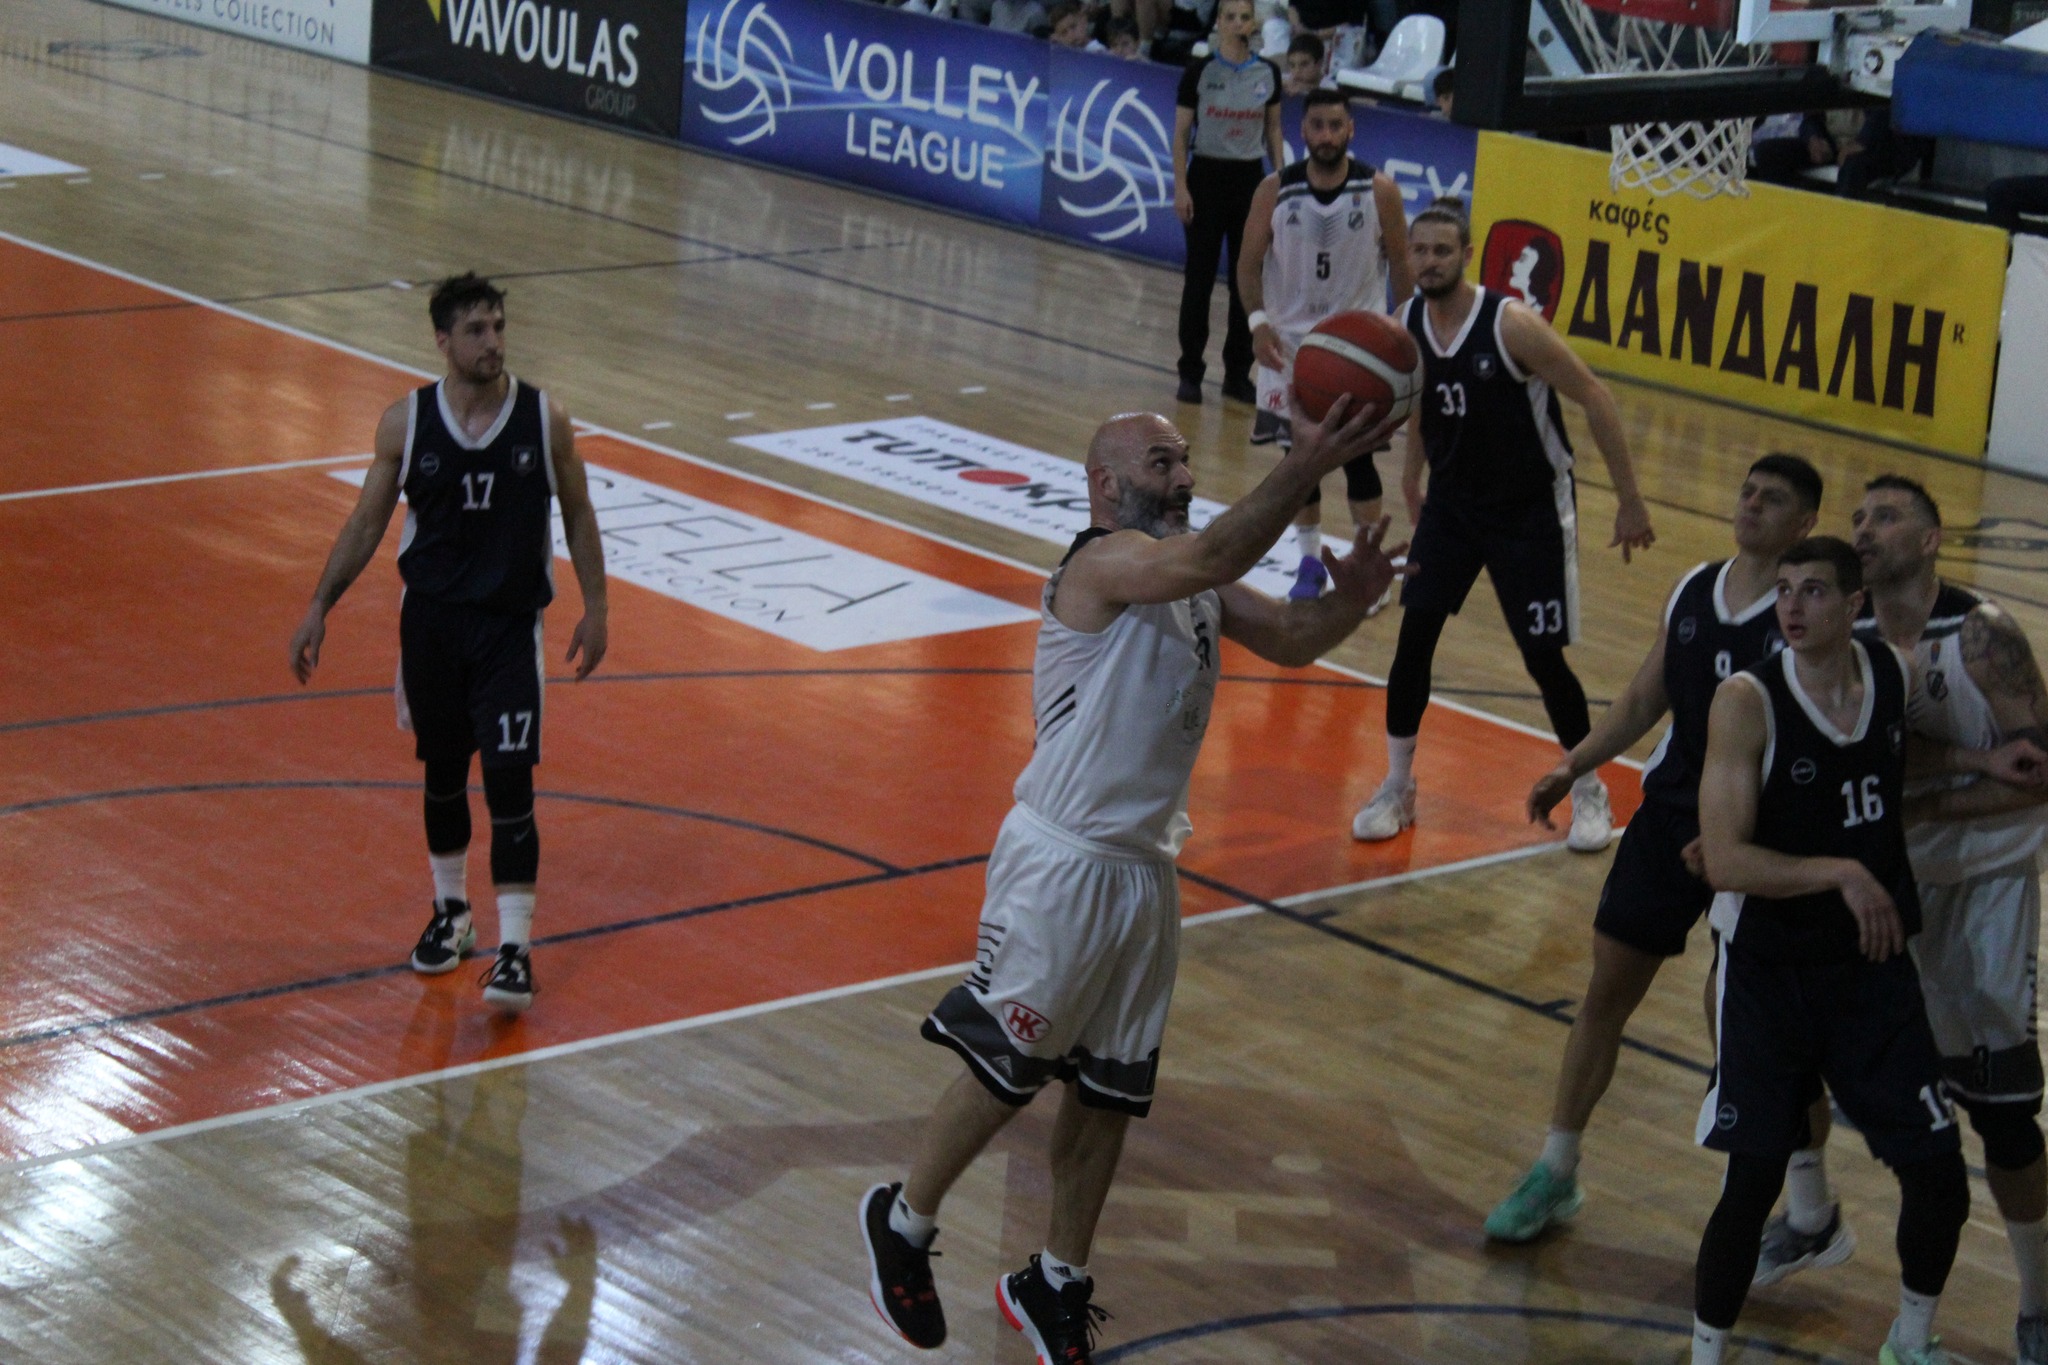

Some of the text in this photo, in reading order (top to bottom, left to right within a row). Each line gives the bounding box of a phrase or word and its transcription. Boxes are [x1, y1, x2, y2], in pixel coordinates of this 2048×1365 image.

[213, 0, 335, 45] COLLECTION
[447, 0, 640, 88] VAVOULAS
[585, 84, 636, 117] GROUP
[824, 32, 1039, 132] VOLLEY
[846, 112, 1006, 189] LEAGUE
[1589, 198, 1670, 245] καφές
[1315, 251, 1331, 281] 5
[1567, 238, 1946, 418] ΔΑΝΔΑΛΗ
[1436, 382, 1467, 417] 33
[461, 472, 495, 510] 17
[1527, 600, 1562, 636] 33
[498, 711, 532, 751] 17
[1841, 775, 1885, 828] 16
[1008, 1006, 1045, 1039] HK
